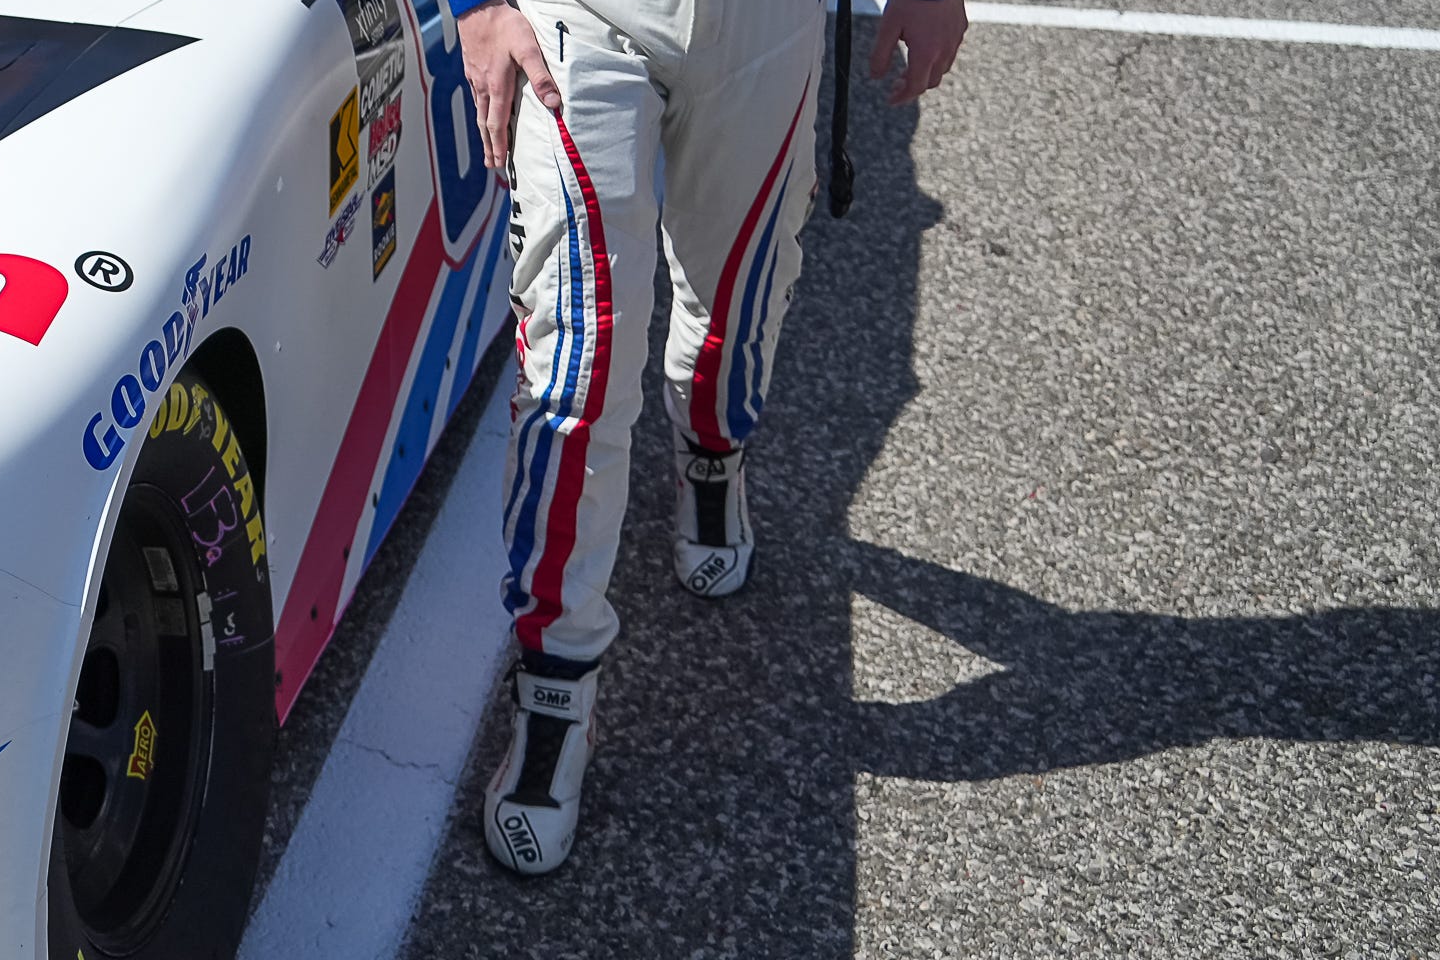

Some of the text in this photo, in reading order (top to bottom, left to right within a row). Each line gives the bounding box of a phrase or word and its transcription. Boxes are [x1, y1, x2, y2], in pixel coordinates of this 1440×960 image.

[692, 556, 726, 591] OMP
[533, 689, 571, 707] OMP
[136, 725, 151, 774] AERO
[504, 816, 537, 865] OMP
